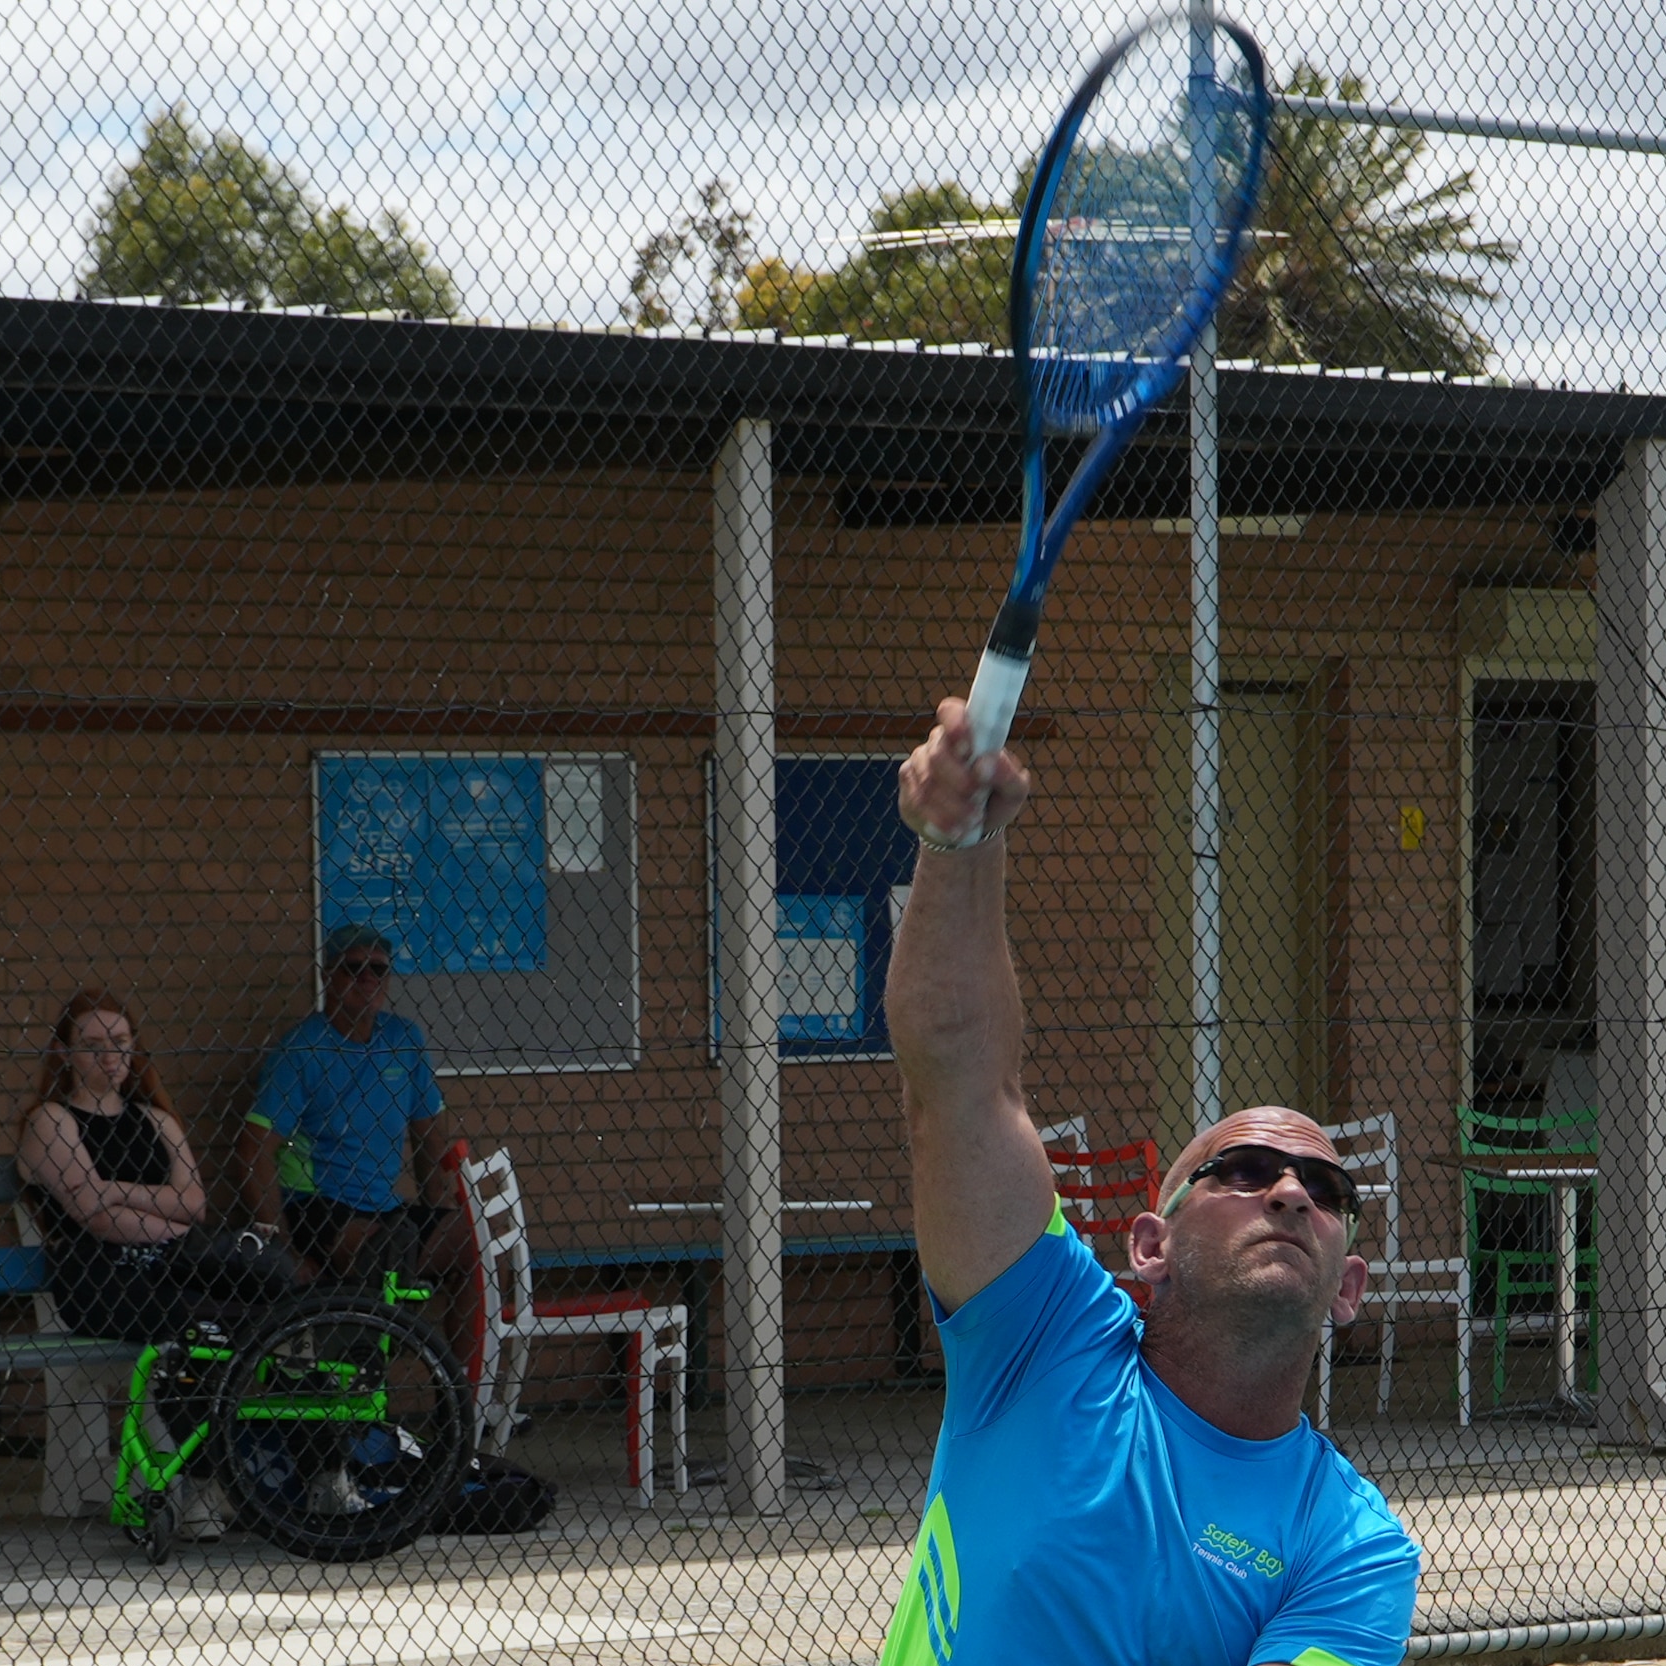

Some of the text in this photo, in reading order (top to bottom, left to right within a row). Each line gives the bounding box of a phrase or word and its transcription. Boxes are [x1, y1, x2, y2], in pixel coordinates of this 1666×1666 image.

[338, 809, 419, 829] DO YOU
[1193, 1542, 1248, 1580] Tennis Club
[1203, 1523, 1284, 1576] Safety Bay
